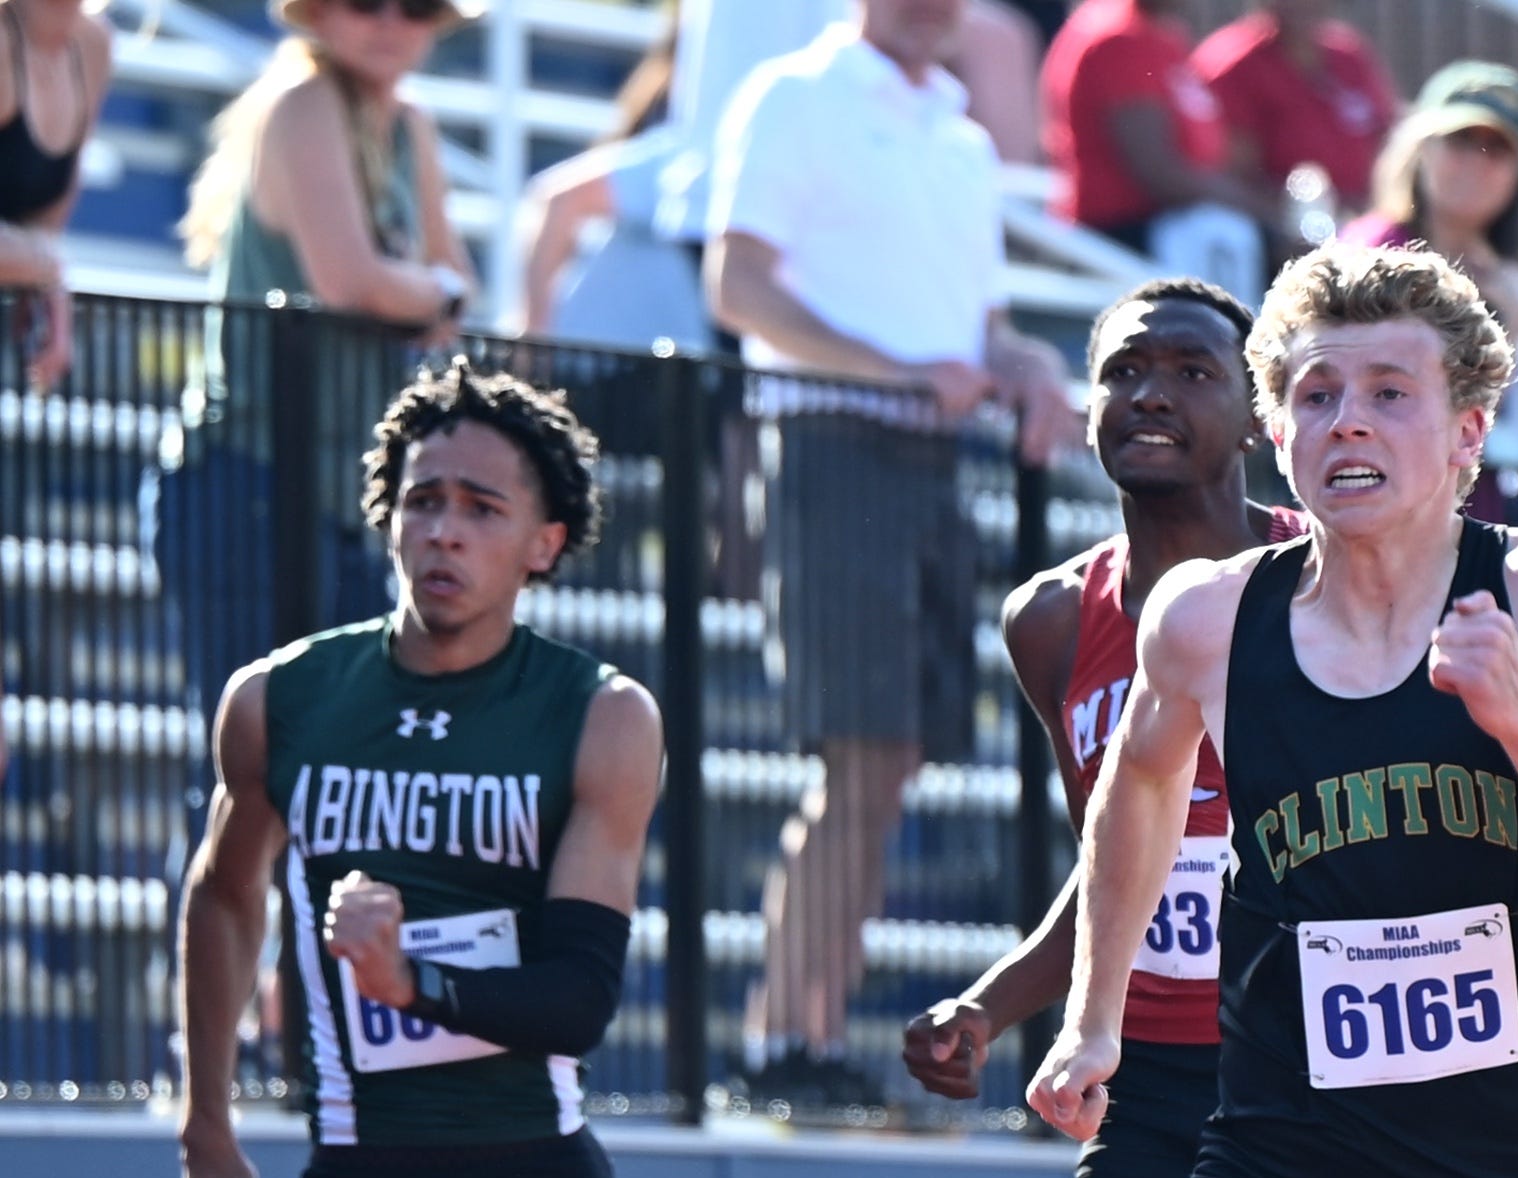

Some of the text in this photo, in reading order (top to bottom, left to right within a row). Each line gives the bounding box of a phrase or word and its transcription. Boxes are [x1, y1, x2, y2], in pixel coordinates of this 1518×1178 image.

[1254, 762, 1518, 885] CLINTON
[1172, 860, 1216, 874] nships
[1382, 924, 1421, 941] MIAA
[1346, 938, 1462, 961] Championships
[1321, 968, 1502, 1060] 6165
